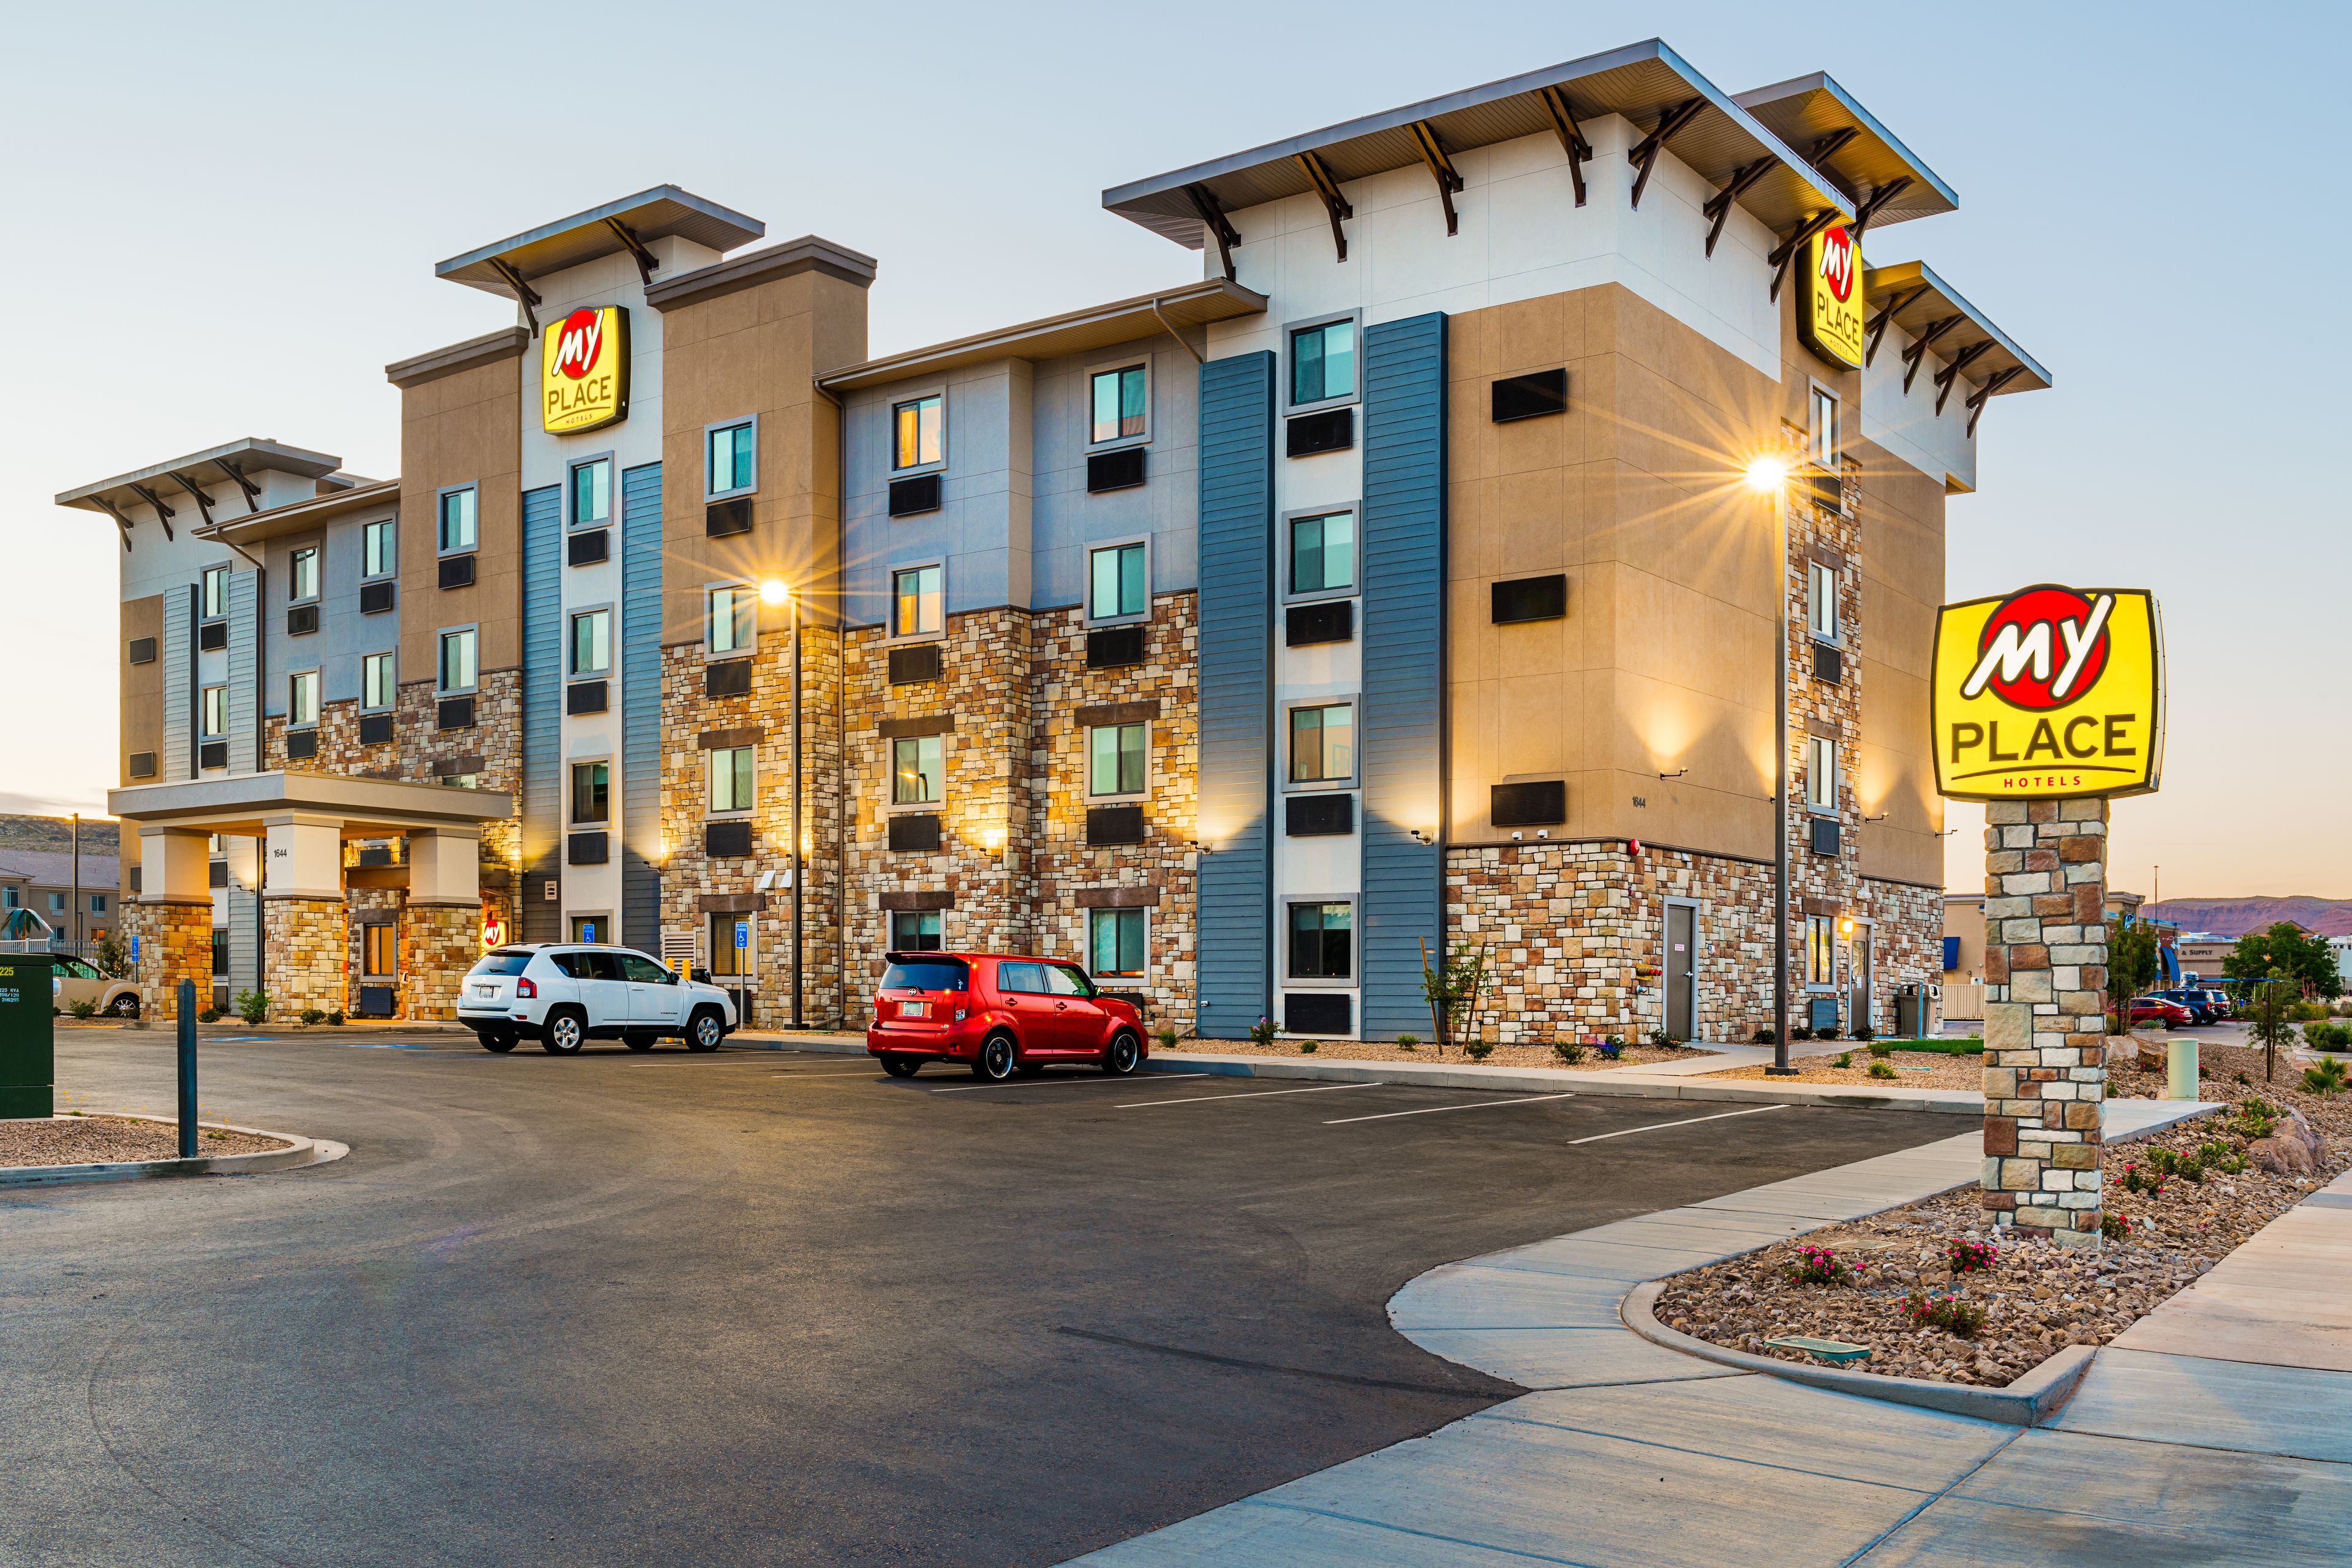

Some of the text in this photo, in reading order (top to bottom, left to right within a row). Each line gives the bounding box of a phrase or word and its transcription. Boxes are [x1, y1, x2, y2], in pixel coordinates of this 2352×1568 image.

[1817, 290, 1860, 346] PLACE
[1830, 337, 1849, 356] HOTELS
[548, 375, 611, 415] PLACE
[566, 413, 593, 425] HOTELS
[1951, 713, 2136, 764] PLACE
[2003, 775, 2081, 788] HOTELS
[1632, 796, 1646, 809] 1644
[274, 849, 287, 858] 1644
[0, 967, 13, 976] 225
